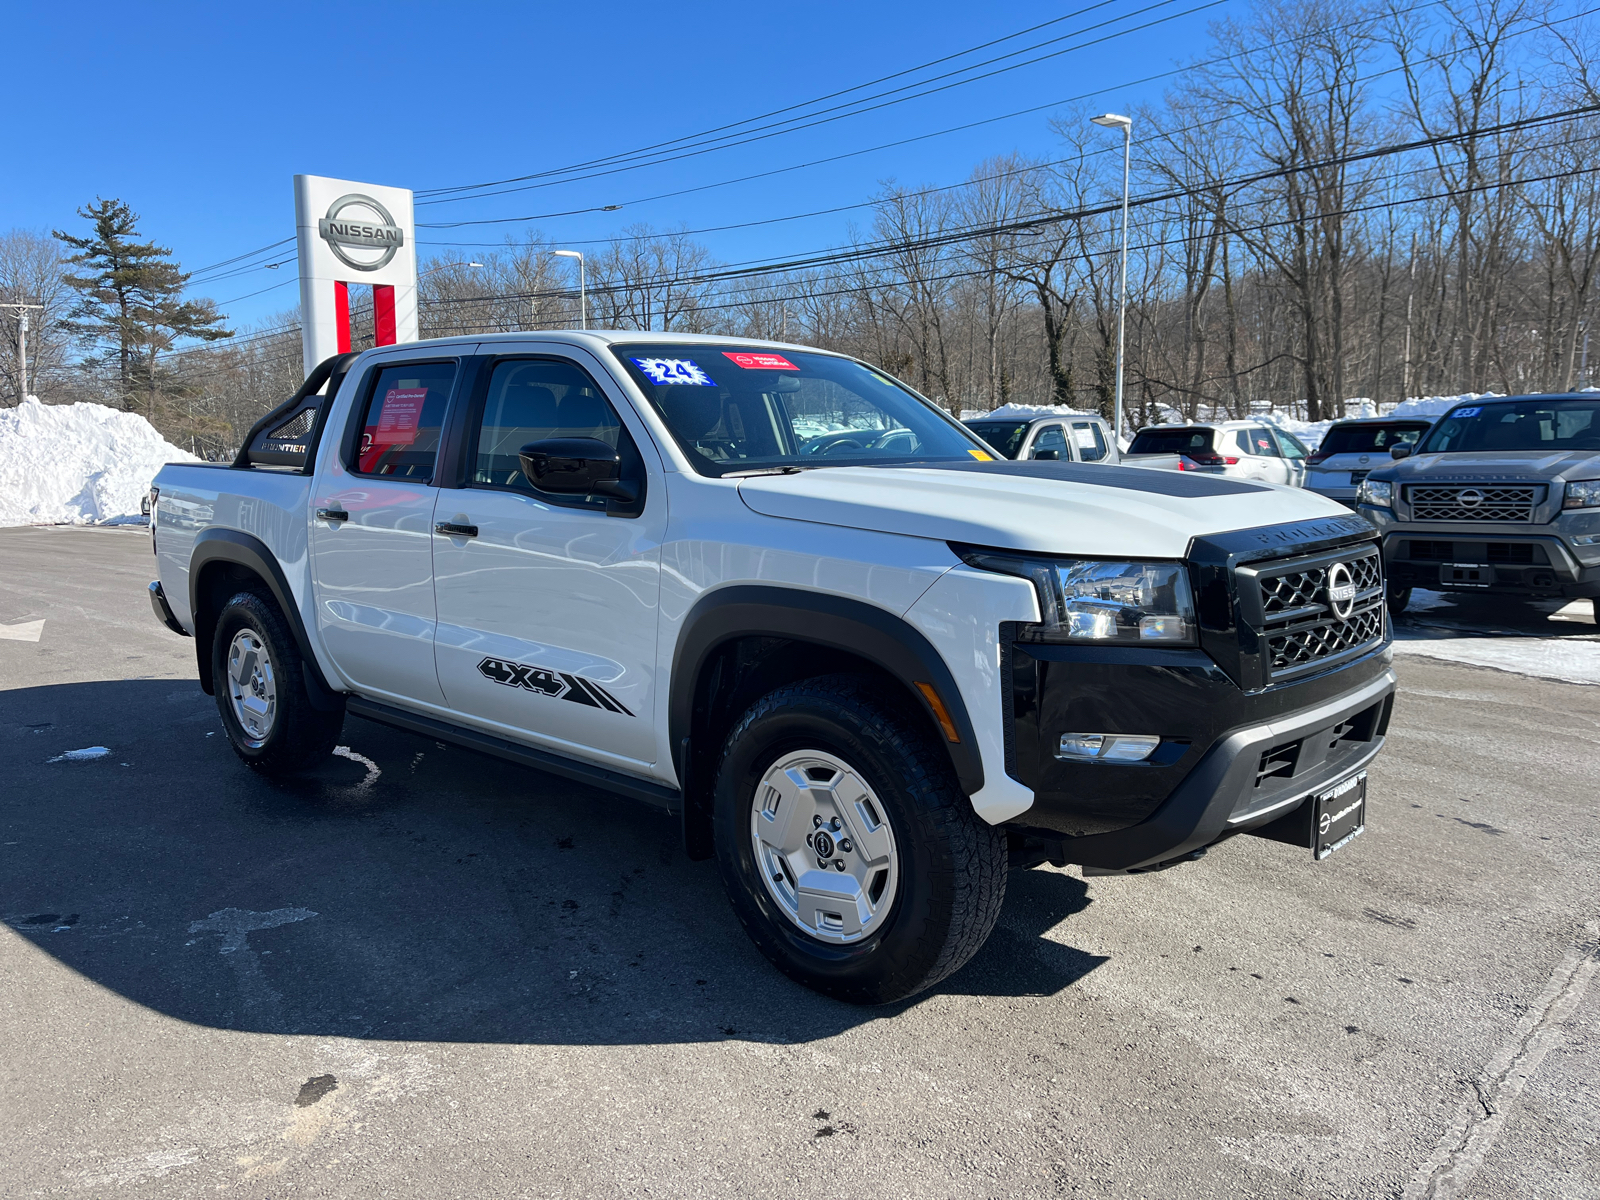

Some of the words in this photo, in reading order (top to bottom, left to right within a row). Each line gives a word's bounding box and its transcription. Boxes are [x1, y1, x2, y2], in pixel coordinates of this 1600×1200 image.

[330, 223, 398, 242] NISSAN
[655, 362, 692, 378] 24
[261, 442, 306, 453] FRONTIER
[1330, 586, 1356, 601] NISS
